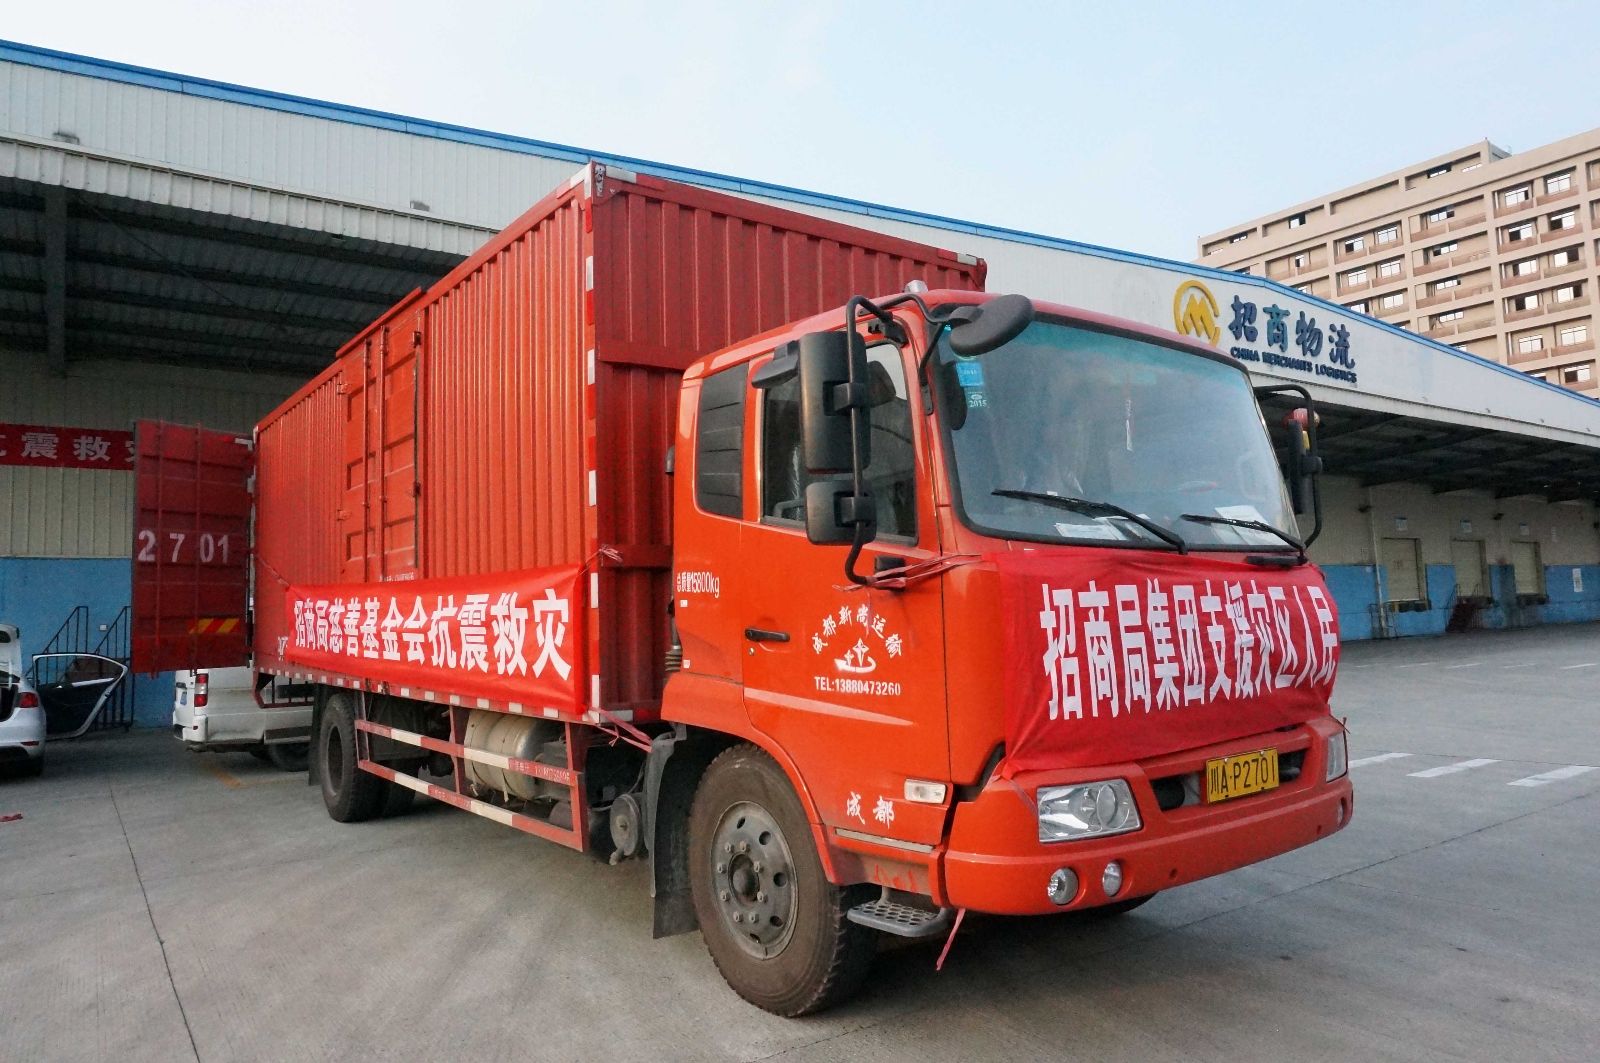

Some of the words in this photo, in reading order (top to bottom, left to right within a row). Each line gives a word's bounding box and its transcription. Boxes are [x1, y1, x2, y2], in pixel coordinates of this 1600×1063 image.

[1228, 295, 1355, 369] 招商物流
[1230, 346, 1260, 362] CHINA
[1262, 351, 1313, 373] MERCHANTS
[1315, 363, 1357, 383] LOGISTICS
[968, 399, 987, 407] 2015
[293, 588, 571, 680] 招商局慈善基金会抗震救灾
[1040, 578, 1337, 720] 招商局集团支援灾区人民
[814, 676, 901, 696] TEL:13880473260
[847, 791, 895, 829] 成都
